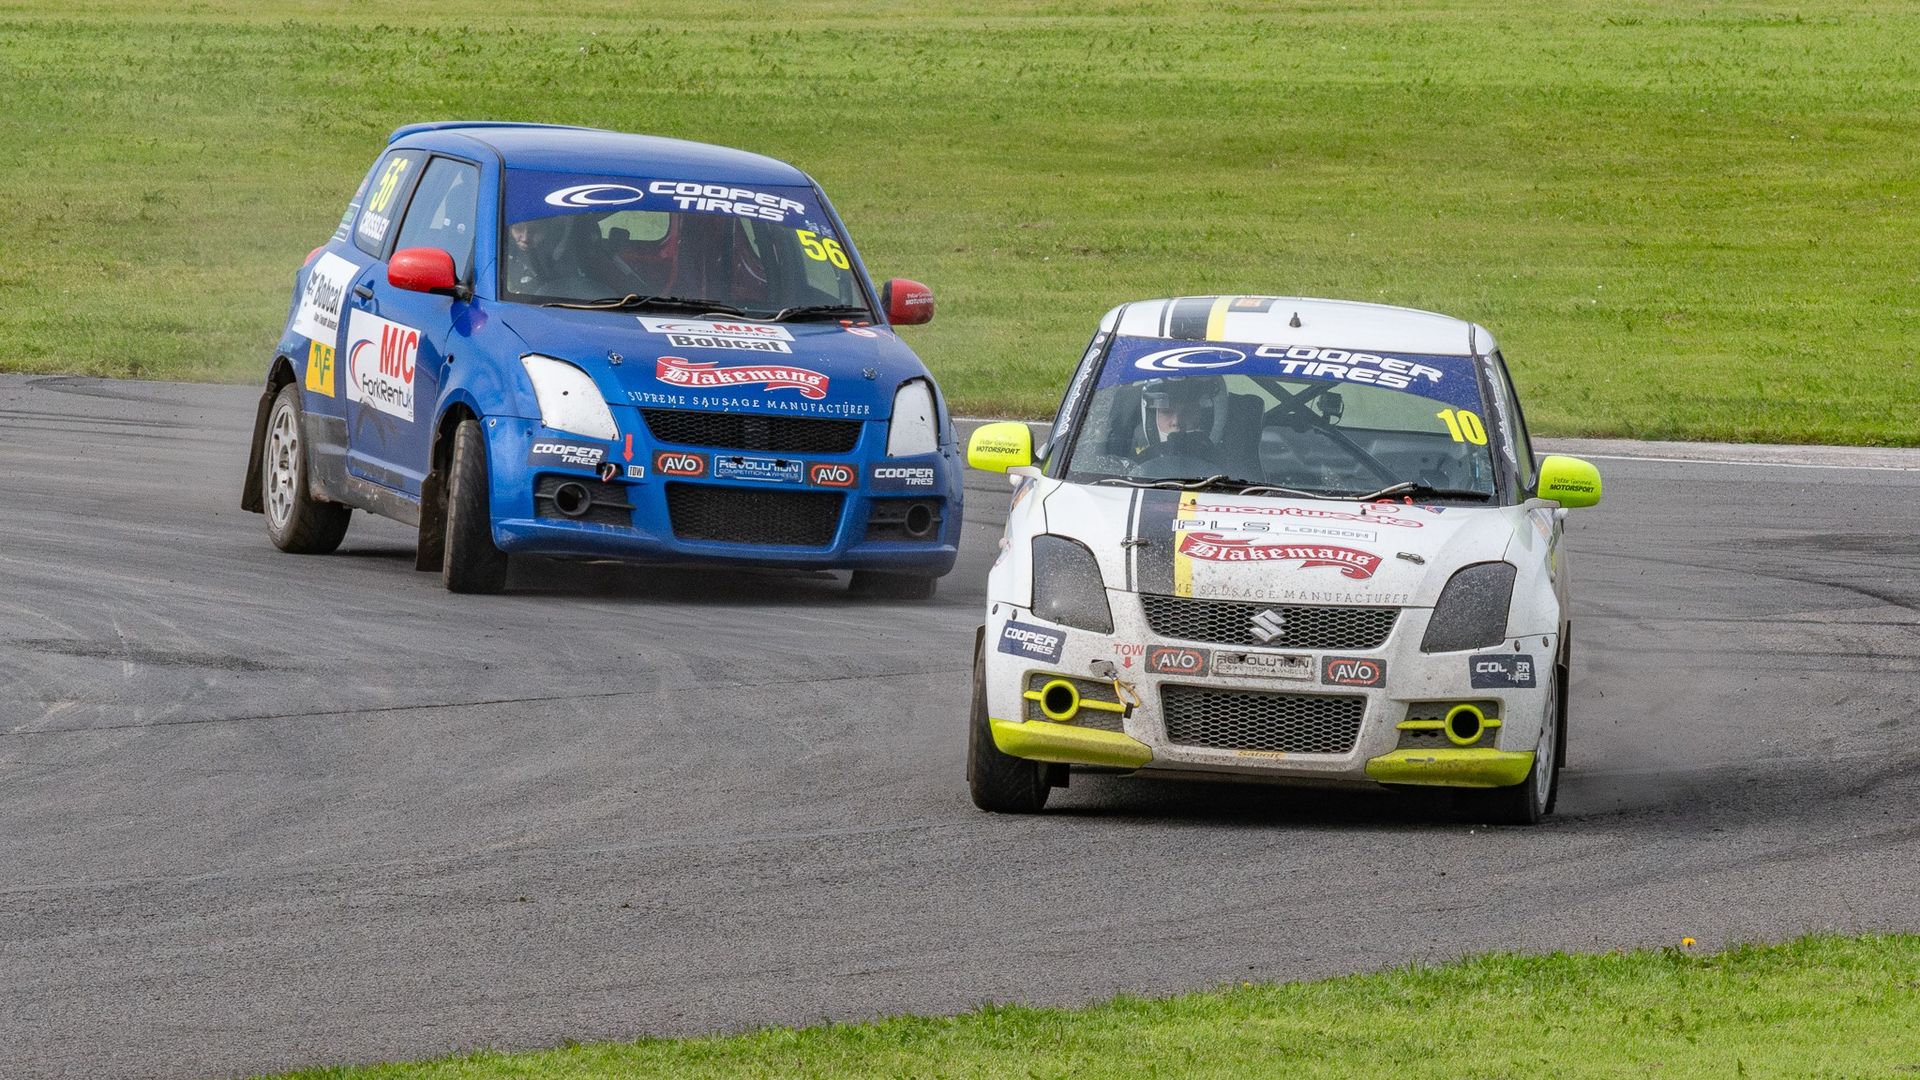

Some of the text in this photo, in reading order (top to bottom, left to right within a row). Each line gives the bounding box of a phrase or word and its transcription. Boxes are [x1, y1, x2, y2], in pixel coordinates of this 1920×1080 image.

[369, 158, 407, 212] 56
[648, 181, 805, 215] COOPER
[673, 195, 786, 221] TIRES
[796, 229, 850, 270] 56
[313, 273, 342, 316] Bobcat
[712, 324, 778, 334] MJC
[671, 335, 783, 351] Bobcat
[380, 324, 417, 385] MJC
[1254, 344, 1444, 383] COOPER
[664, 366, 823, 387] Blakemans
[1279, 359, 1413, 389] TIRES
[627, 391, 871, 415] SUPREME SAUSAGE MANUFACTURER
[1436, 408, 1488, 446] 10
[532, 443, 604, 459] COOPER
[976, 446, 1020, 454] MOTORSPORT
[561, 454, 600, 466] TIRES
[663, 454, 697, 473] AVO
[629, 466, 643, 477] TOW
[817, 465, 848, 484] AVO
[874, 468, 934, 479] COOPER
[905, 477, 934, 486] TIRES
[1550, 484, 1594, 493] MOTORSPORT
[1178, 520, 1369, 539] PLS LONDON
[1184, 542, 1376, 566] Blakemans
[1200, 584, 1276, 599] SAUSAGE
[1284, 589, 1409, 604] MANUFACTURER
[1004, 627, 1059, 648] COOPER
[1022, 642, 1055, 656] TIRES
[1113, 643, 1146, 656] TOW
[1158, 650, 1195, 670] AVO
[1476, 661, 1530, 673] COER
[1335, 661, 1372, 682] AVO
[1507, 672, 1530, 681] TES
